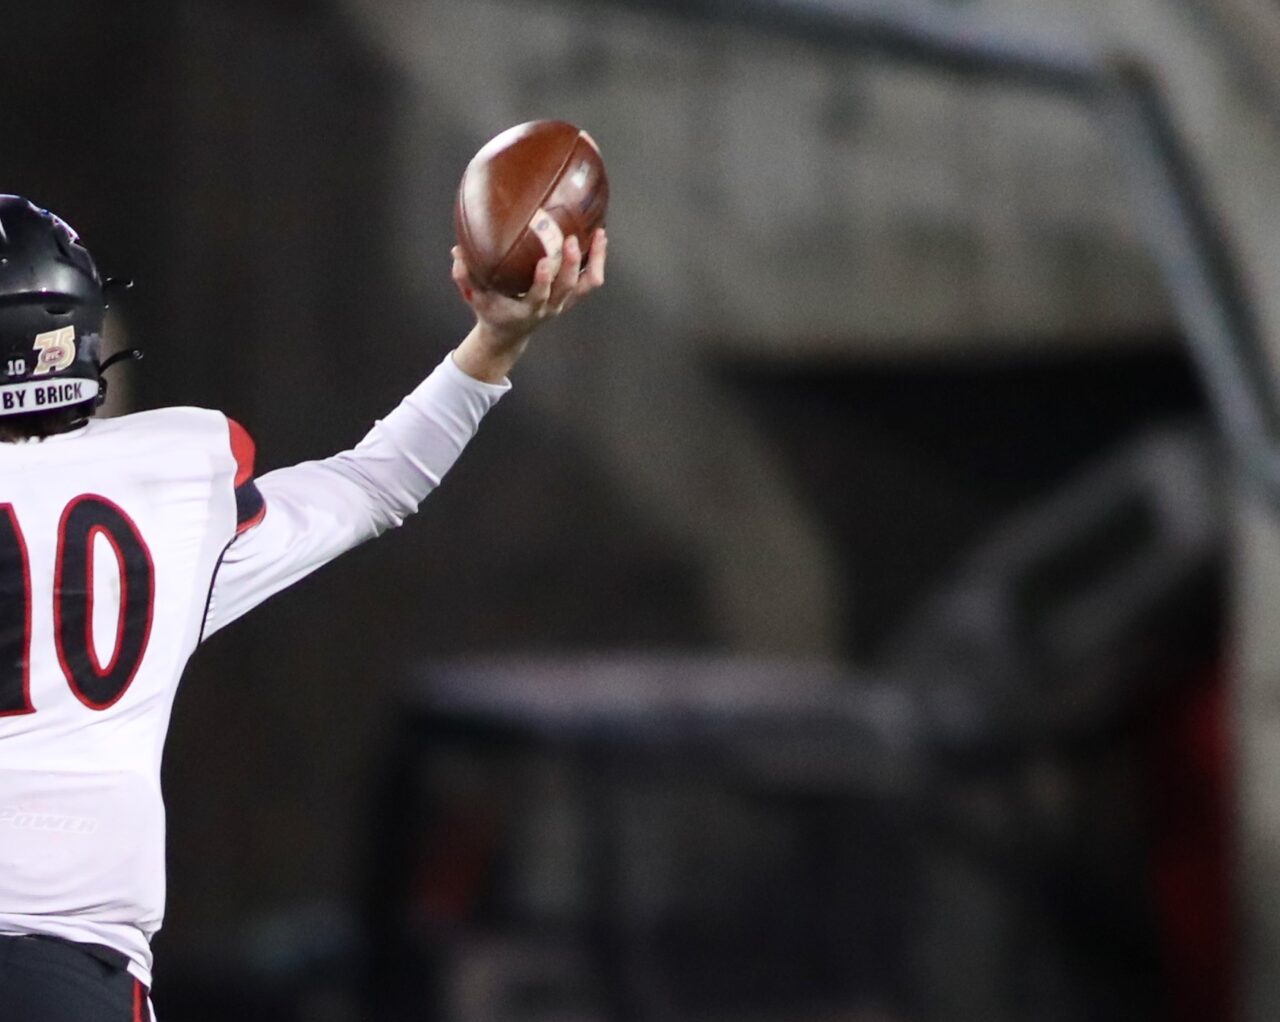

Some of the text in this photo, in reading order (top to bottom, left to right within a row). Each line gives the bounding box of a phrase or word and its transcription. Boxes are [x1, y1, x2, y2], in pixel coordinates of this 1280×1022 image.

[7, 358, 26, 376] 10
[2, 389, 27, 410] BY
[34, 382, 83, 406] BRICK
